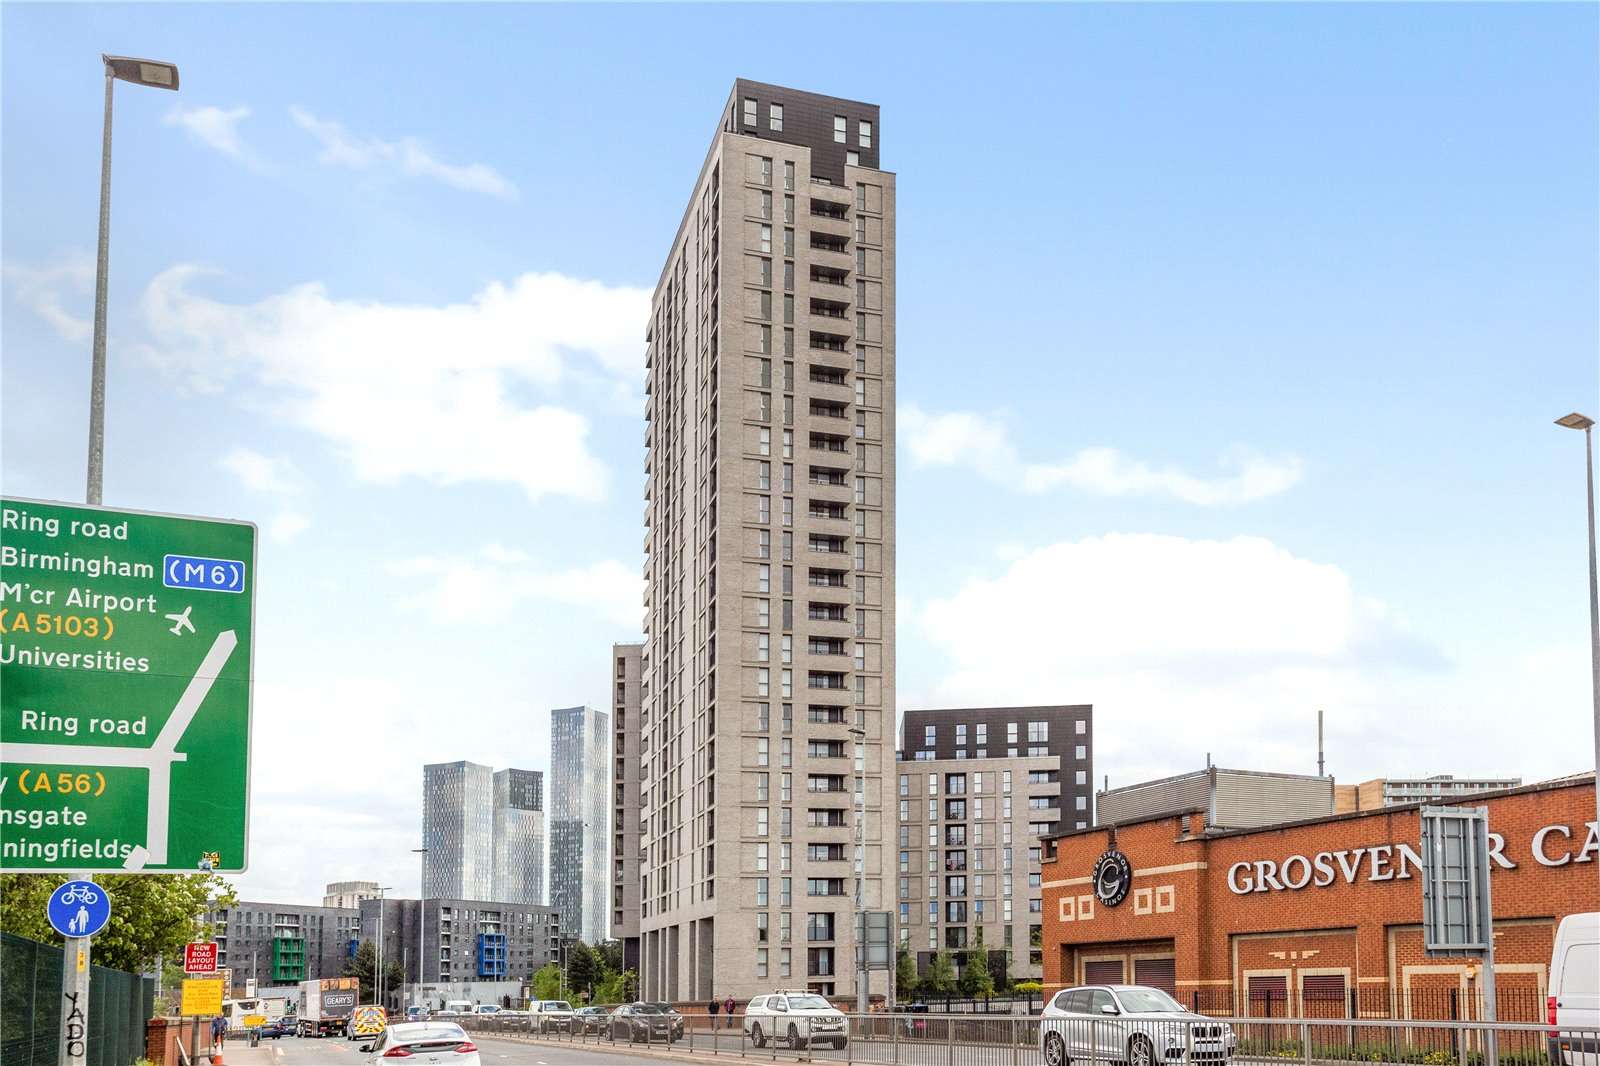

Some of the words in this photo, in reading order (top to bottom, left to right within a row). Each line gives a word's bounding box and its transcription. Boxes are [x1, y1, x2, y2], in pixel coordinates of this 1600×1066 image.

[2, 509, 59, 537] Ring
[70, 521, 128, 540] road
[1, 546, 154, 578] Birmingham
[65, 587, 157, 614] Airport
[0, 644, 150, 672] Universities
[21, 710, 78, 736] Ring
[89, 716, 147, 735] road
[4, 838, 132, 862] ningfields
[1226, 833, 1516, 895] GROSVENR
[326, 996, 352, 1005] GEARY'S
